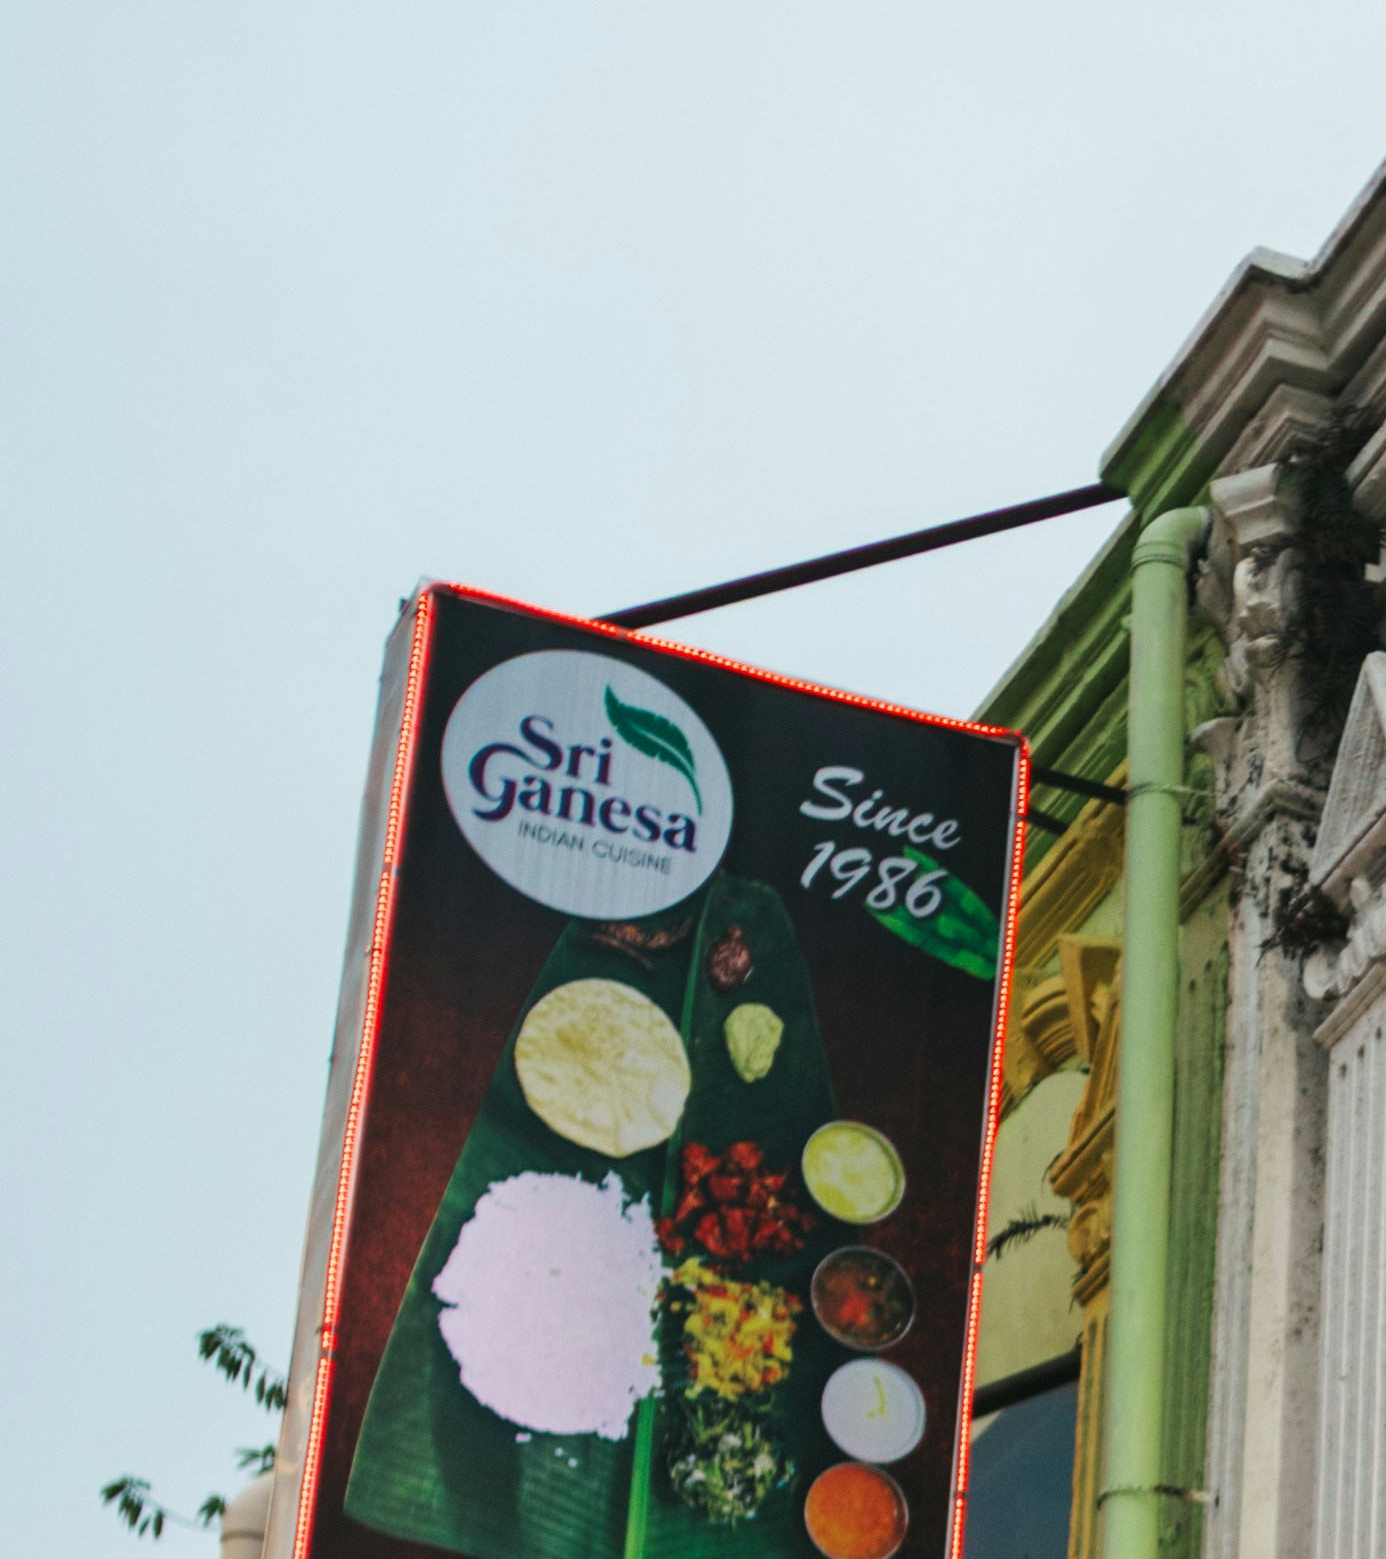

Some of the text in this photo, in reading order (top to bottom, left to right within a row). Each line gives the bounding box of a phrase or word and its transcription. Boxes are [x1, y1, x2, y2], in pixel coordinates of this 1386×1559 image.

[519, 713, 614, 787] Sri
[468, 741, 698, 853] Ganesa
[799, 764, 962, 850] Since
[517, 820, 672, 876] INDIAN CUISINE
[800, 840, 948, 919] 1986
